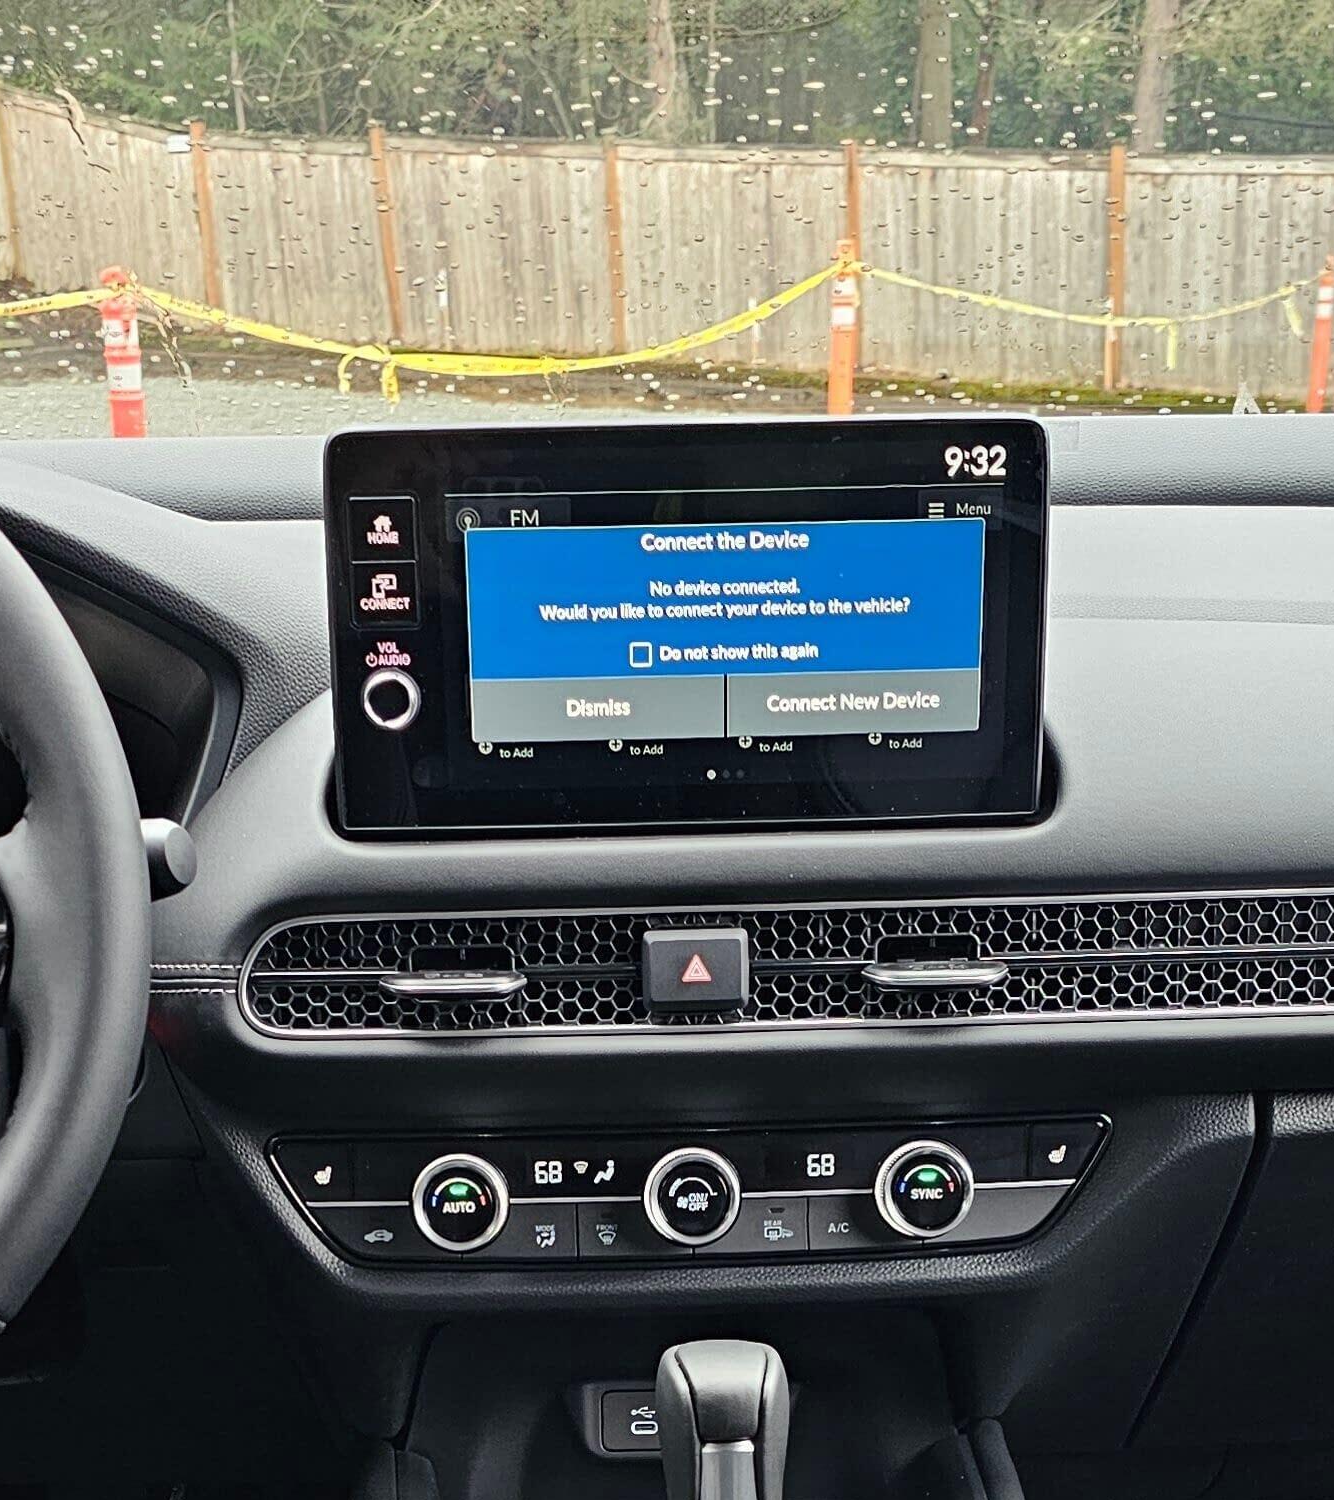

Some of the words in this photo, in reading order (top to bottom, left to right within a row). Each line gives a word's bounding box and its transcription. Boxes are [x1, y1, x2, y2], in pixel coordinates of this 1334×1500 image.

[944, 444, 1007, 477] 9:32
[956, 503, 992, 516] Menu
[510, 509, 539, 527] FM
[367, 531, 399, 544] HOME
[640, 532, 715, 552] Connect
[716, 531, 746, 550] the
[749, 530, 810, 550] Device
[649, 580, 673, 597] No
[674, 580, 721, 597] device
[722, 577, 801, 596] connected.
[360, 597, 410, 611] CONNECT
[539, 603, 588, 621] Would
[588, 606, 618, 622] you
[619, 602, 646, 619] like
[646, 603, 664, 619] to
[665, 602, 724, 618] connect
[724, 603, 760, 619] your
[760, 599, 807, 616] device
[808, 599, 826, 615] to
[827, 598, 853, 614] the
[854, 597, 911, 614] vehicle?
[377, 641, 400, 654] VOL
[659, 645, 682, 662] Do
[683, 645, 709, 661] not
[710, 644, 750, 660] show
[751, 643, 779, 659] this
[780, 642, 819, 661] again
[378, 653, 411, 666] AUDIO
[566, 698, 631, 717] Dismiss
[766, 694, 837, 713] Connect
[840, 693, 880, 711] New
[883, 690, 941, 710] Device
[759, 742, 771, 752] to
[772, 741, 793, 752] Add
[889, 739, 900, 749] to
[901, 737, 923, 749] Add
[499, 748, 512, 758] to
[512, 747, 534, 758] Add
[629, 745, 641, 756] to
[642, 744, 664, 755] Add
[806, 1153, 835, 1177] 68
[534, 1160, 563, 1184] 68
[910, 1188, 944, 1200] SYNC
[442, 1201, 476, 1214] AUTO
[688, 1201, 709, 1212] OFF
[535, 1224, 555, 1232] MODE
[827, 1222, 850, 1234] A/C
